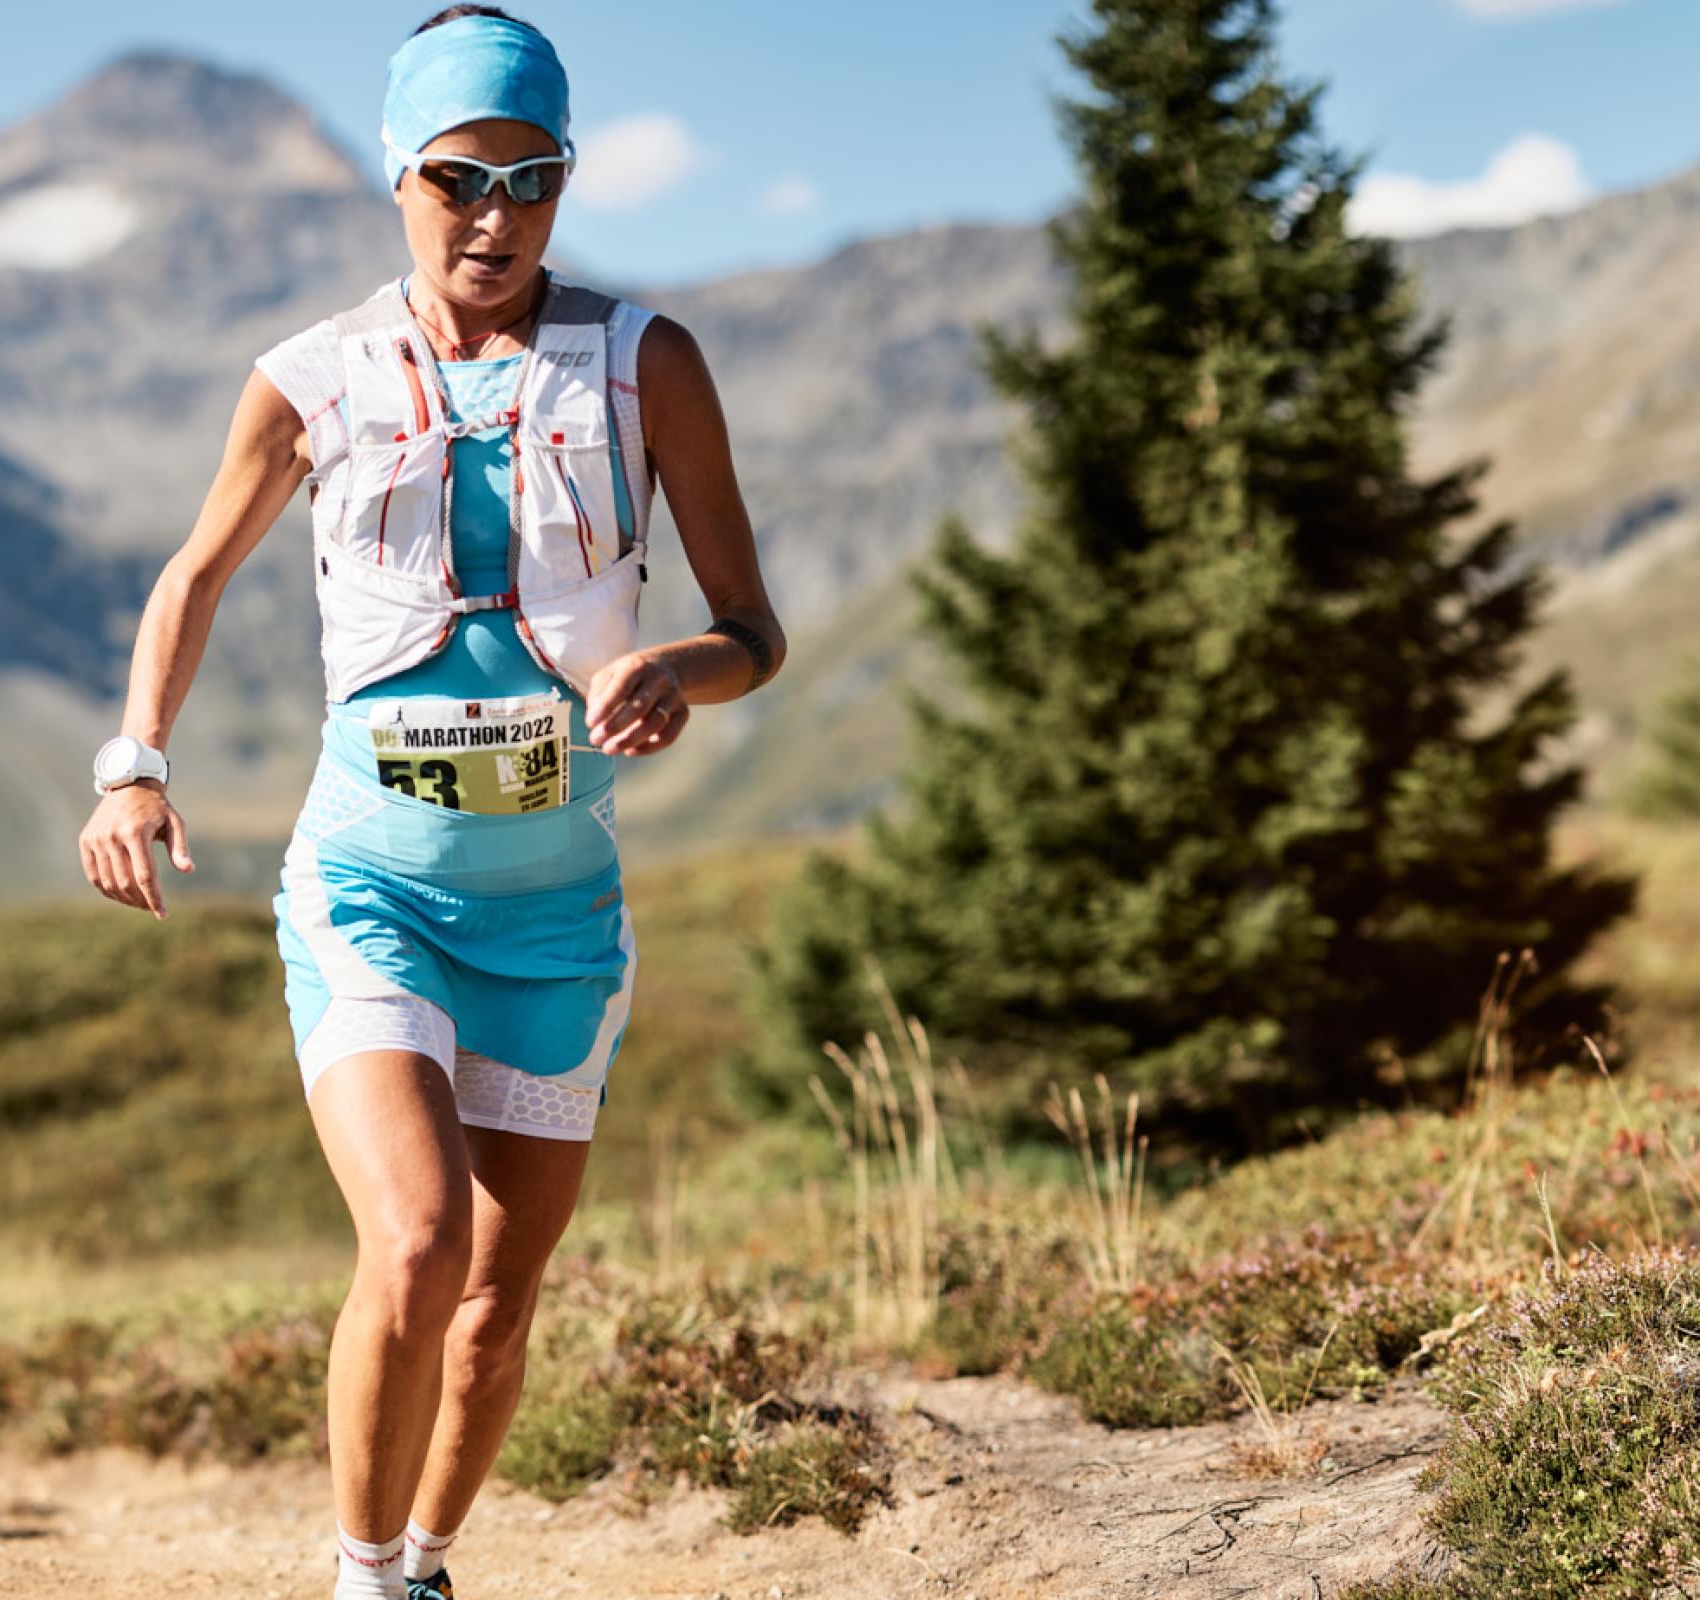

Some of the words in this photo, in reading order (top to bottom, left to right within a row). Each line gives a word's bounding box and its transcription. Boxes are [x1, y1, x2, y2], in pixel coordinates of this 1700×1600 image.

[404, 726, 508, 748] MARATHON
[511, 716, 555, 742] 2022
[377, 759, 460, 810] 53
